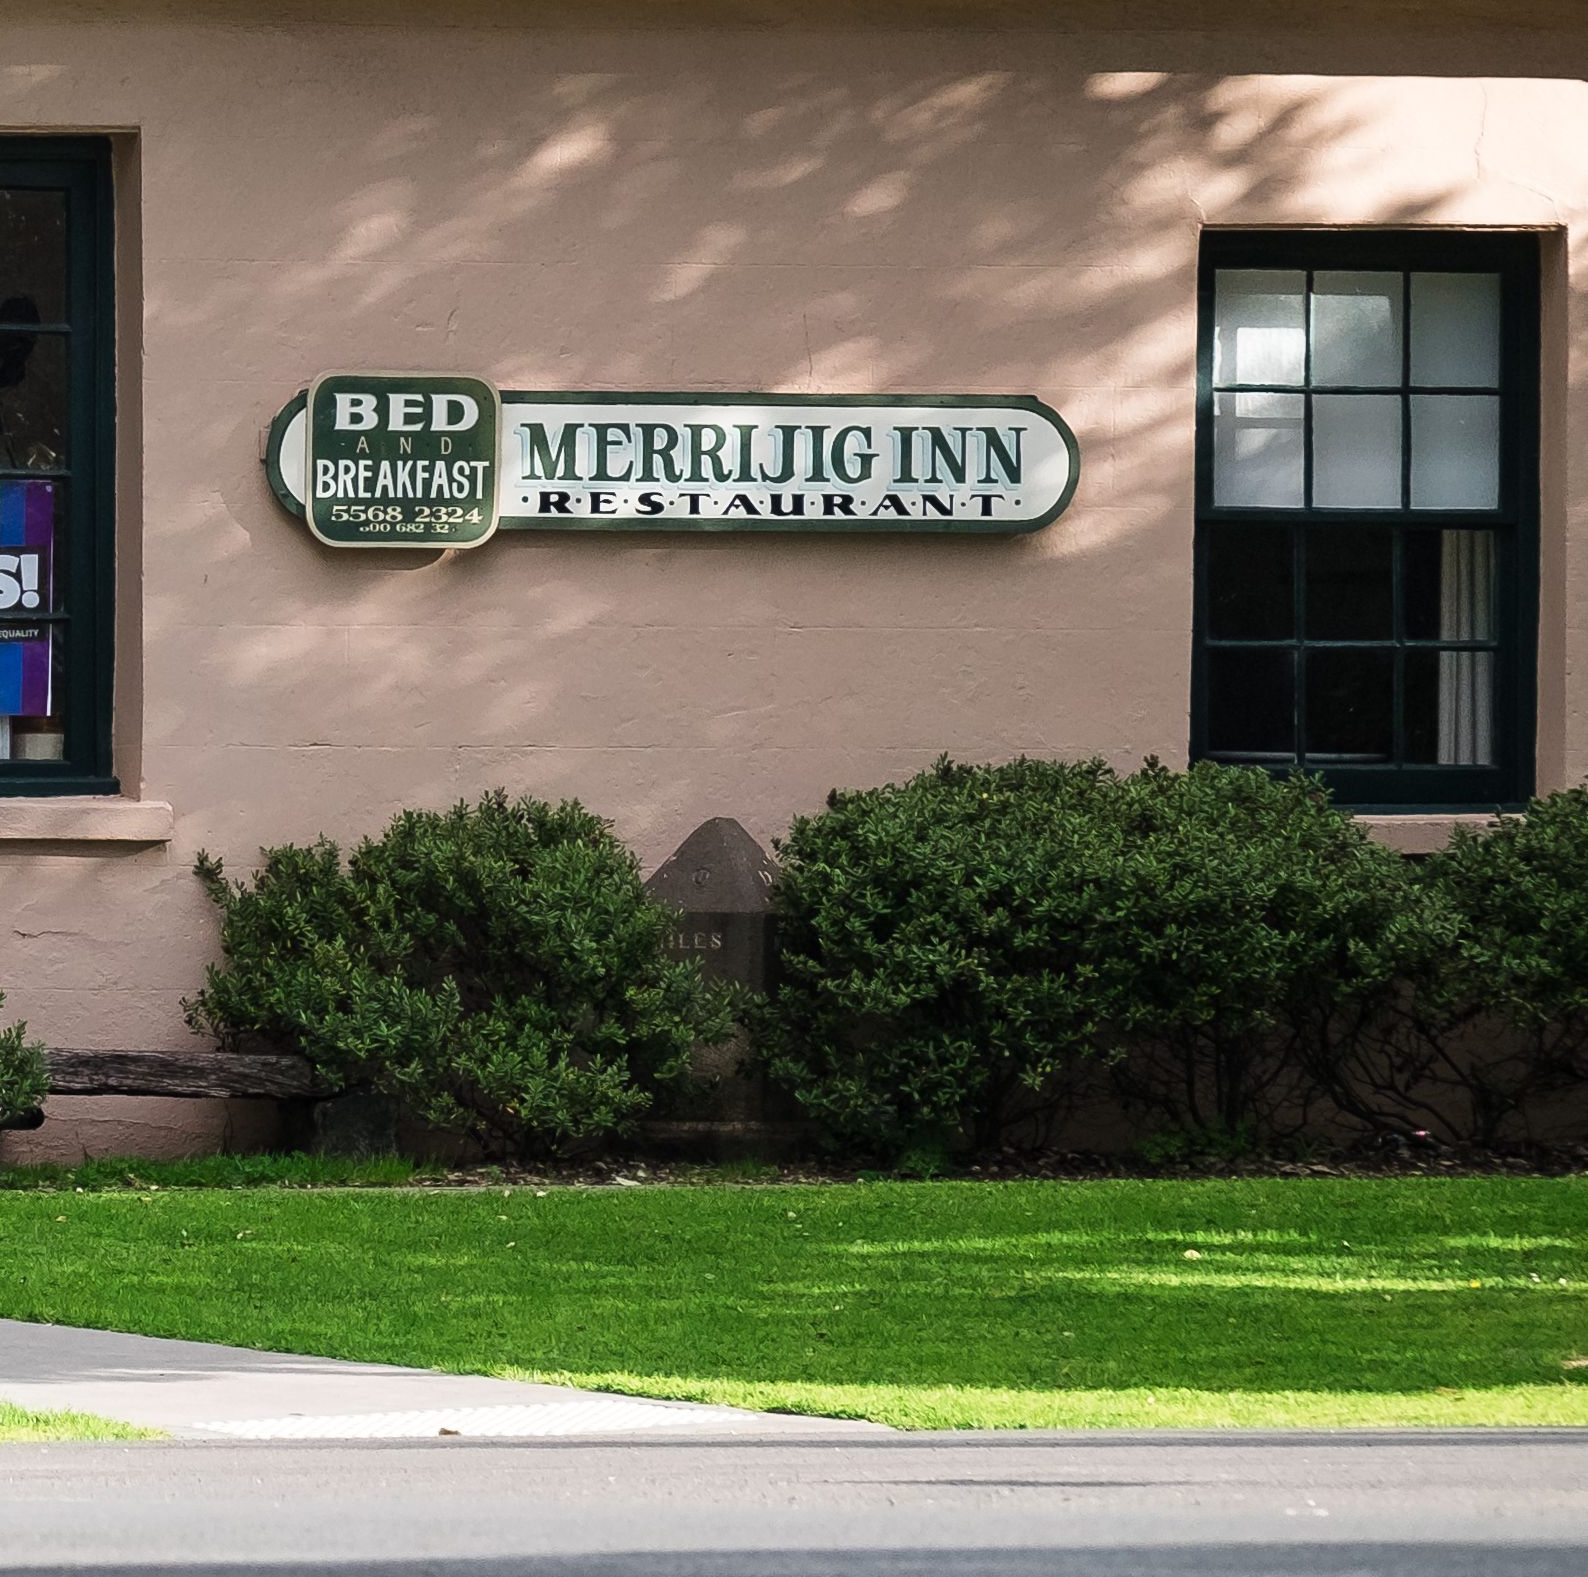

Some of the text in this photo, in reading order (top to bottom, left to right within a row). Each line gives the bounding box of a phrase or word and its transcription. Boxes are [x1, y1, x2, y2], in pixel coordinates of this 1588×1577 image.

[333, 392, 479, 432] BED
[356, 435, 452, 455] AND
[519, 422, 1028, 486] MERRIJIG INN
[316, 458, 490, 500] BREAKFAST
[331, 505, 484, 525] 5568 2324
[536, 490, 1006, 517] RESTAURANT
[396, 522, 424, 533] 682
